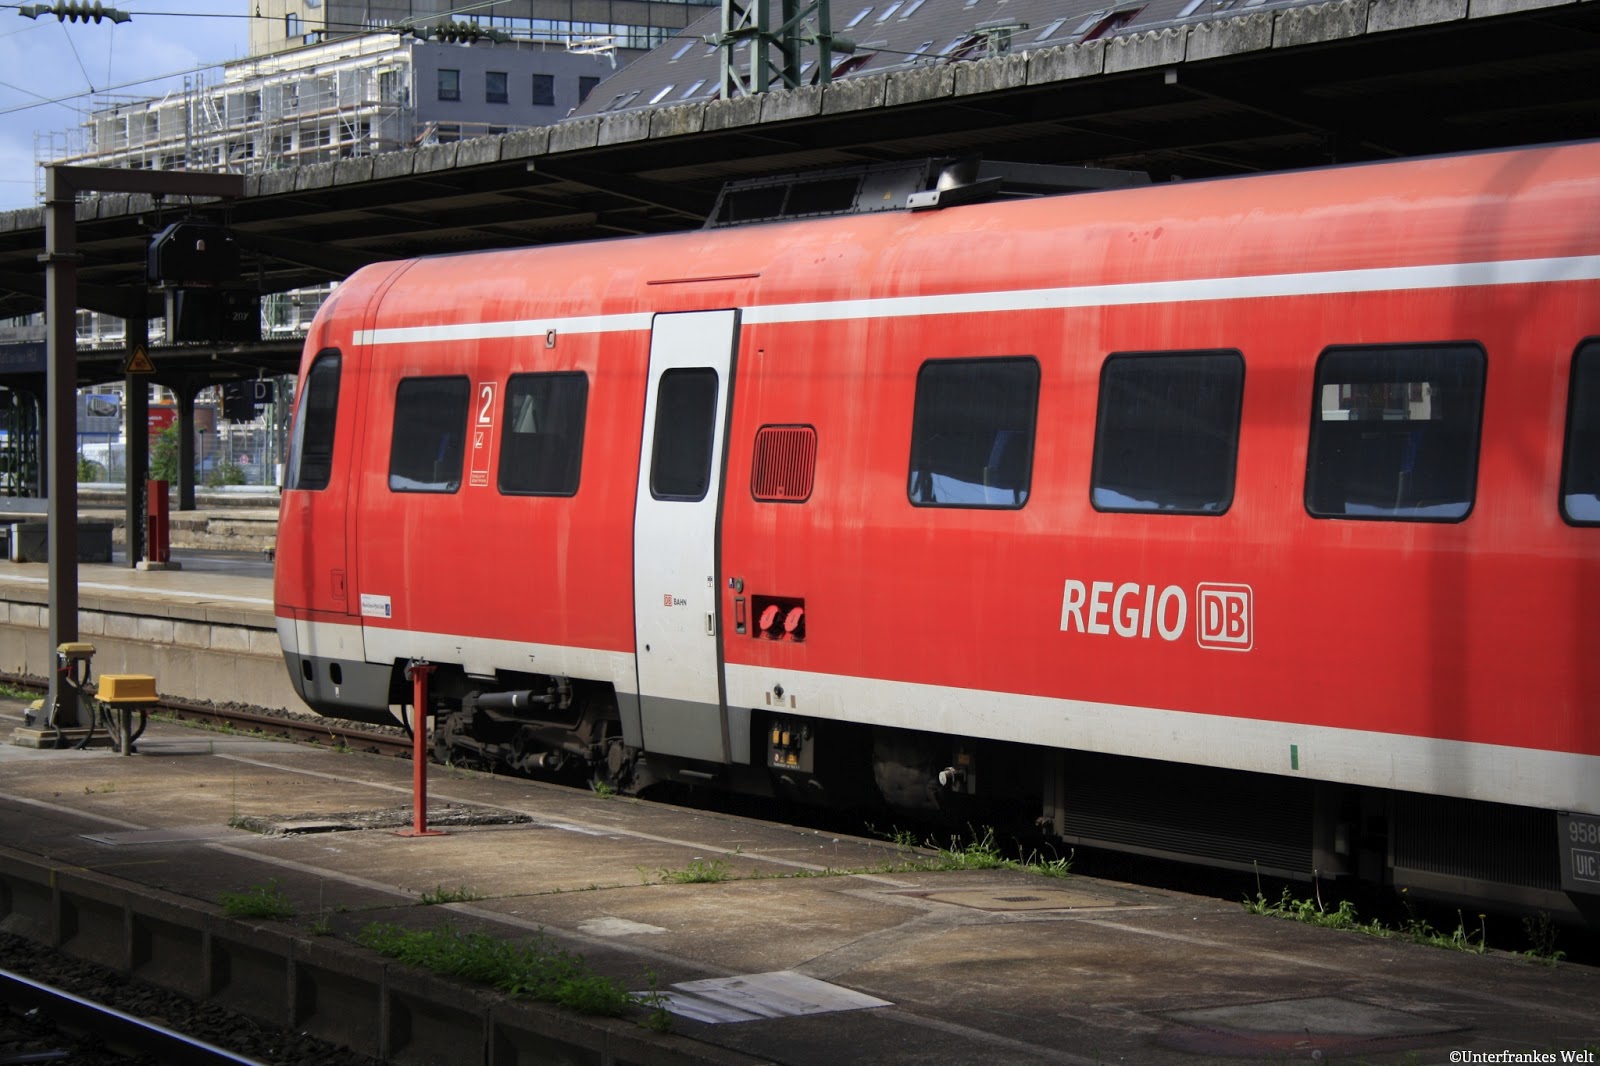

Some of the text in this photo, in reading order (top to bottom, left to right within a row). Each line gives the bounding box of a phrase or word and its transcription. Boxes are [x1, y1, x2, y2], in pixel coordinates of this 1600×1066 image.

[255, 383, 266, 399] D
[479, 386, 492, 423] 2
[673, 597, 688, 606] BAHN
[1060, 579, 1248, 643] REGIO DB
[1576, 854, 1596, 877] UIC
